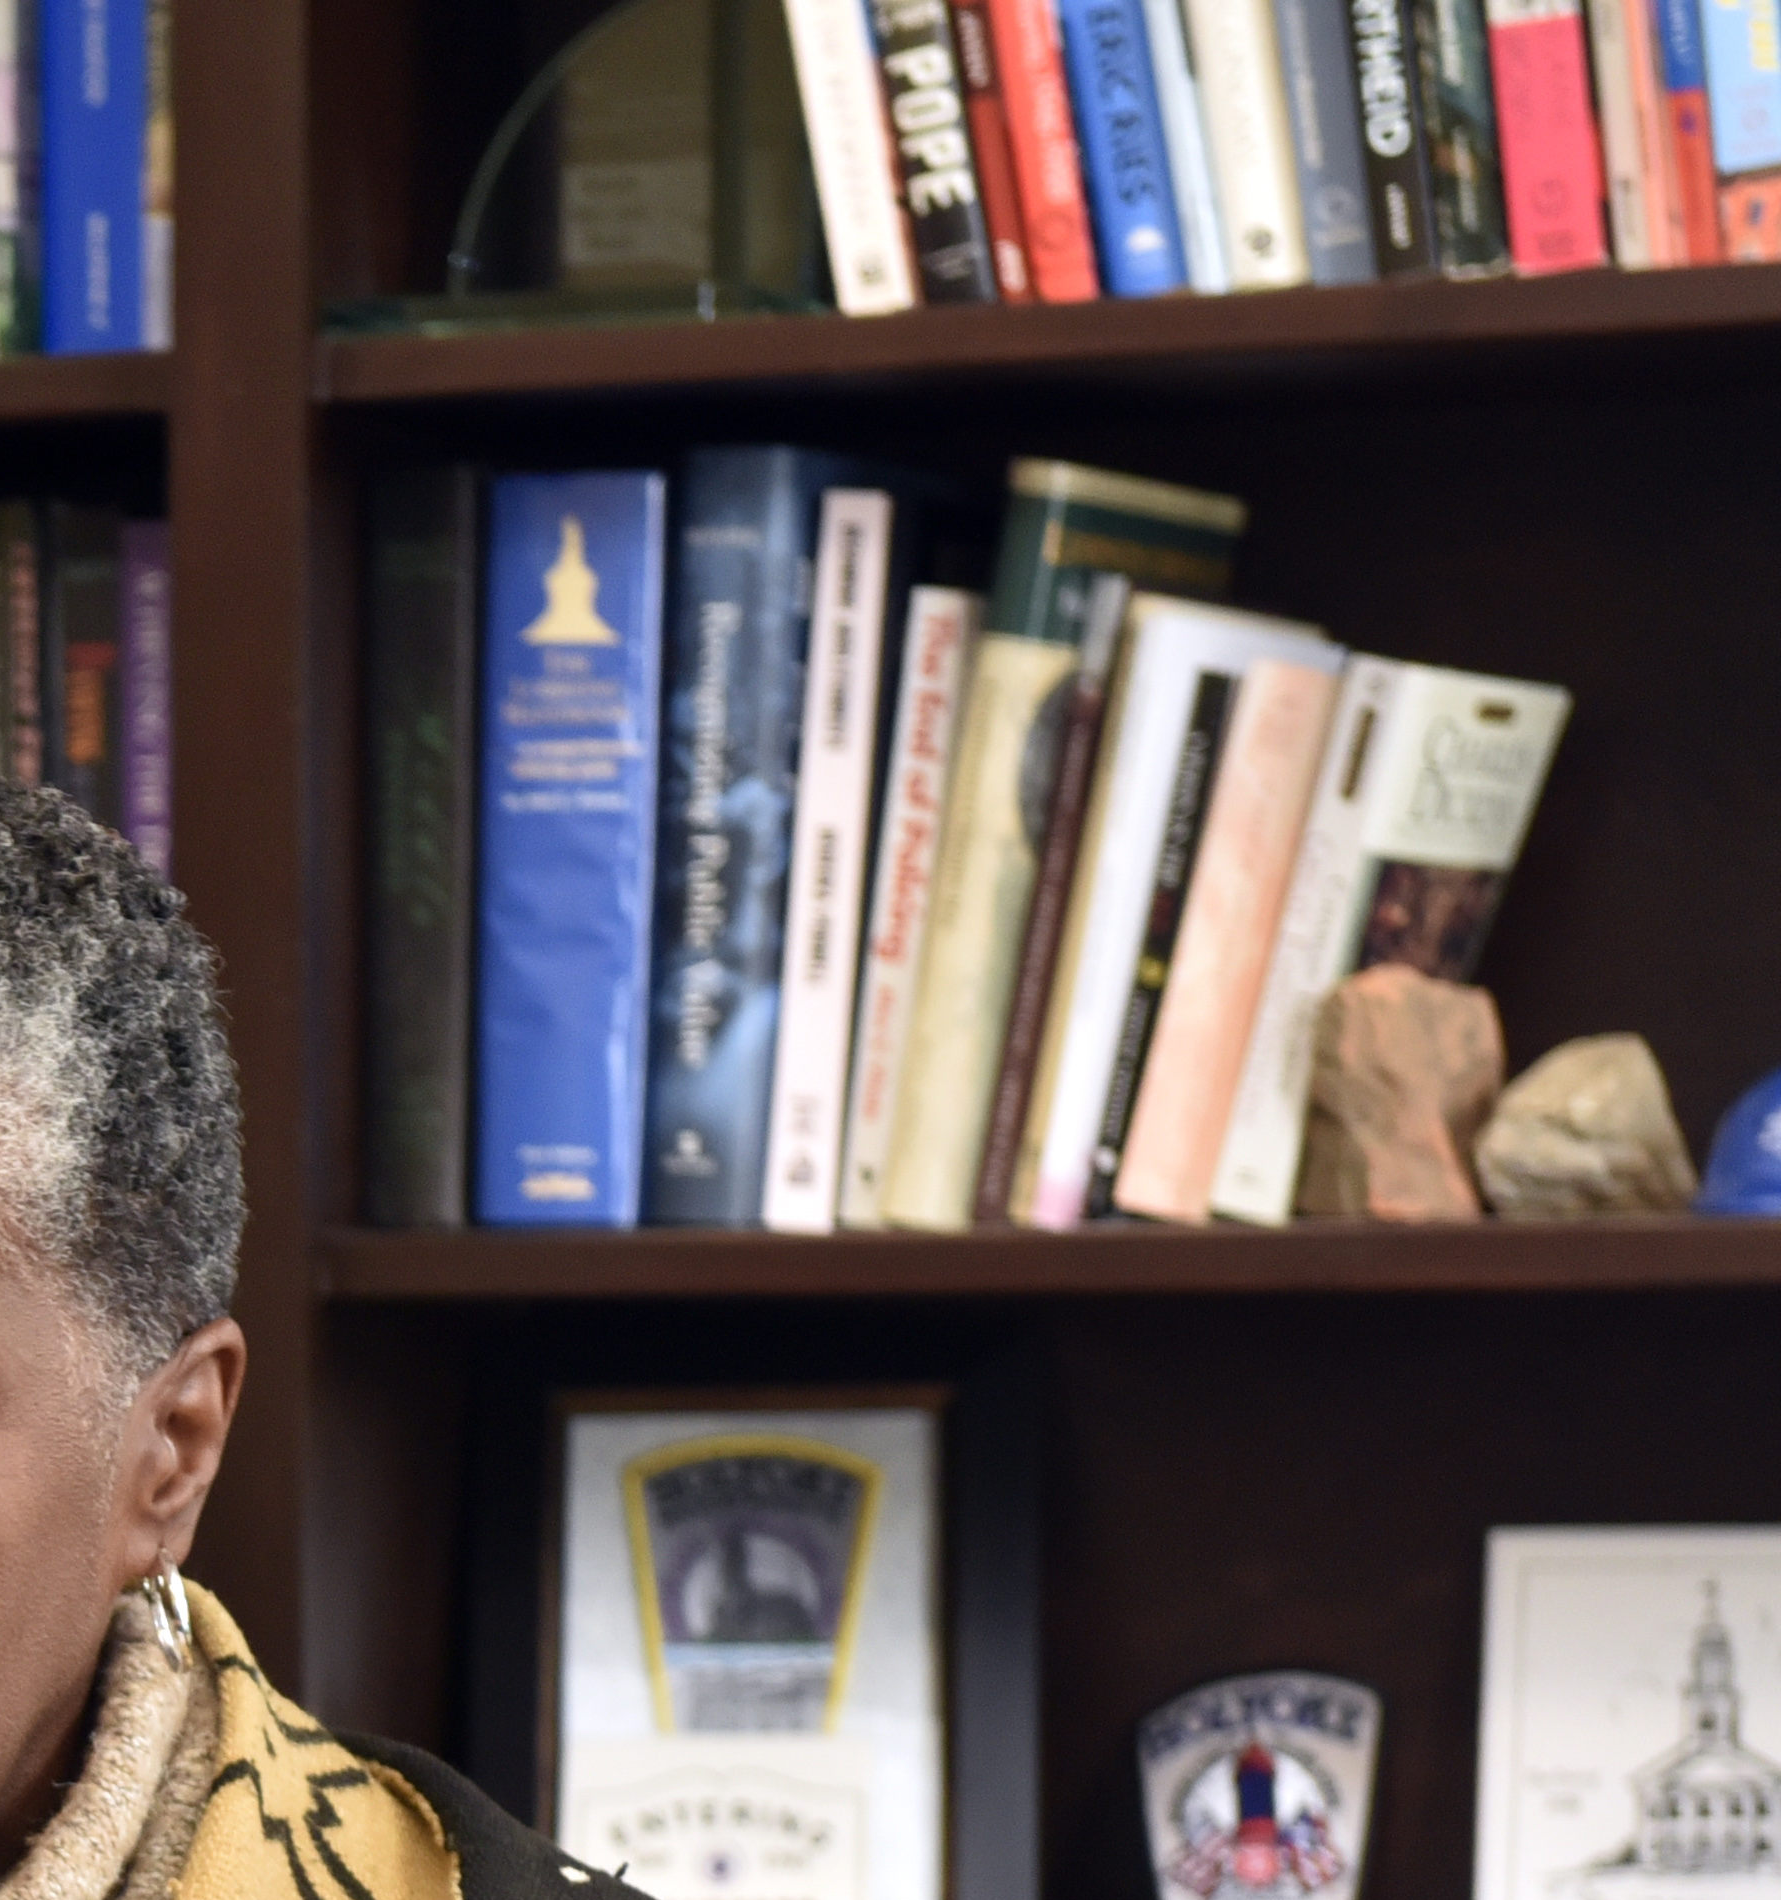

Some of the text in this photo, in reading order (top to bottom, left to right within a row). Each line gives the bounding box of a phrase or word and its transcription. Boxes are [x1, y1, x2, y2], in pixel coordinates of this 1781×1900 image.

[887, 42, 977, 214] POPE
[920, 612, 959, 688] The
[680, 600, 742, 830] Recognizing
[911, 688, 953, 765] End
[905, 766, 940, 817] of
[680, 832, 732, 956] Public
[869, 817, 932, 966] Policing
[607, 1797, 835, 1850] ENTERING
